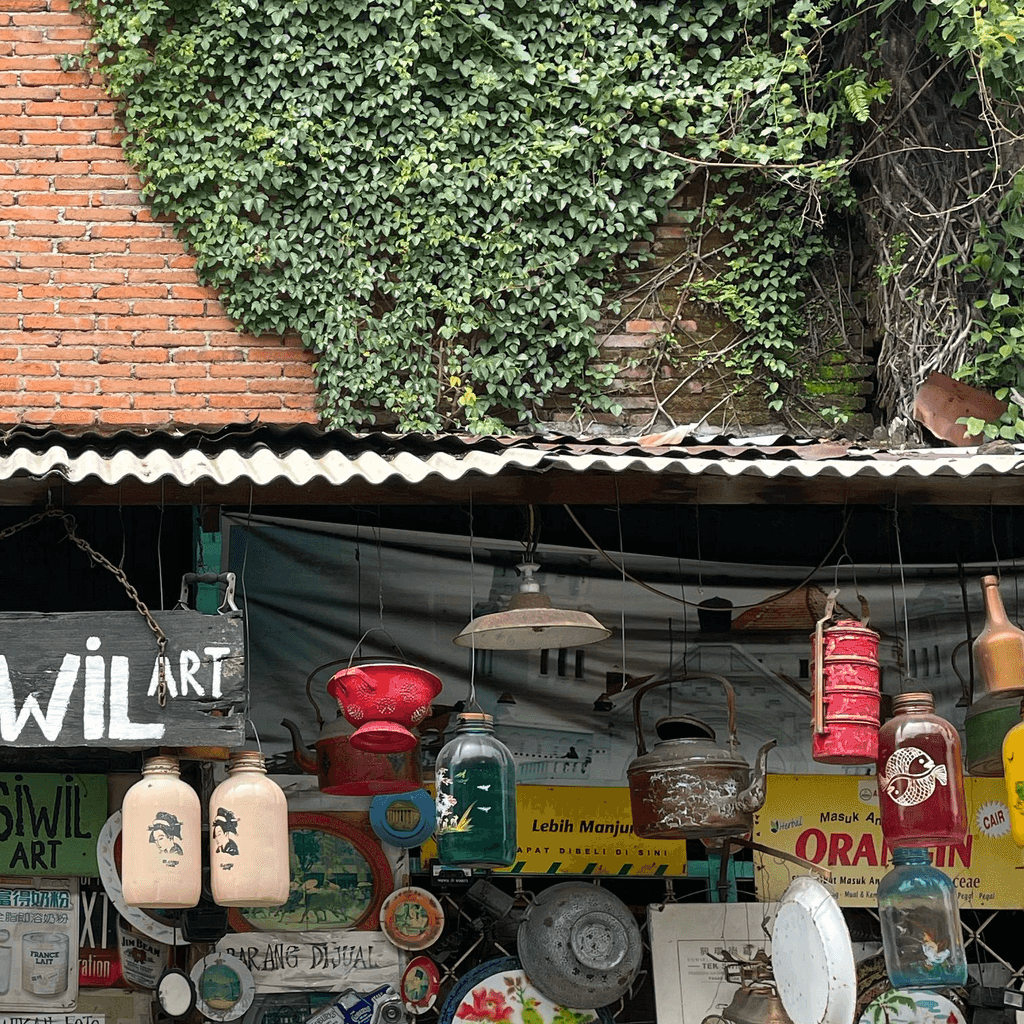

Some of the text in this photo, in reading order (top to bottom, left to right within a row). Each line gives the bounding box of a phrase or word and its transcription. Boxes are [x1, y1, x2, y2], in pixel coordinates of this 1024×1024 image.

[147, 647, 230, 698] ART
[820, 811, 860, 824] Masuk
[983, 810, 1006, 831] CAIR
[532, 819, 574, 833] Lebih
[9, 840, 62, 870] ART
[559, 847, 606, 856] DIBELI
[638, 849, 669, 857] SINI
[839, 876, 867, 885] Masuk
[30, 951, 59, 959] FRANCE
[136, 939, 161, 957] BEAM
[310, 945, 379, 970] DIJUAL
